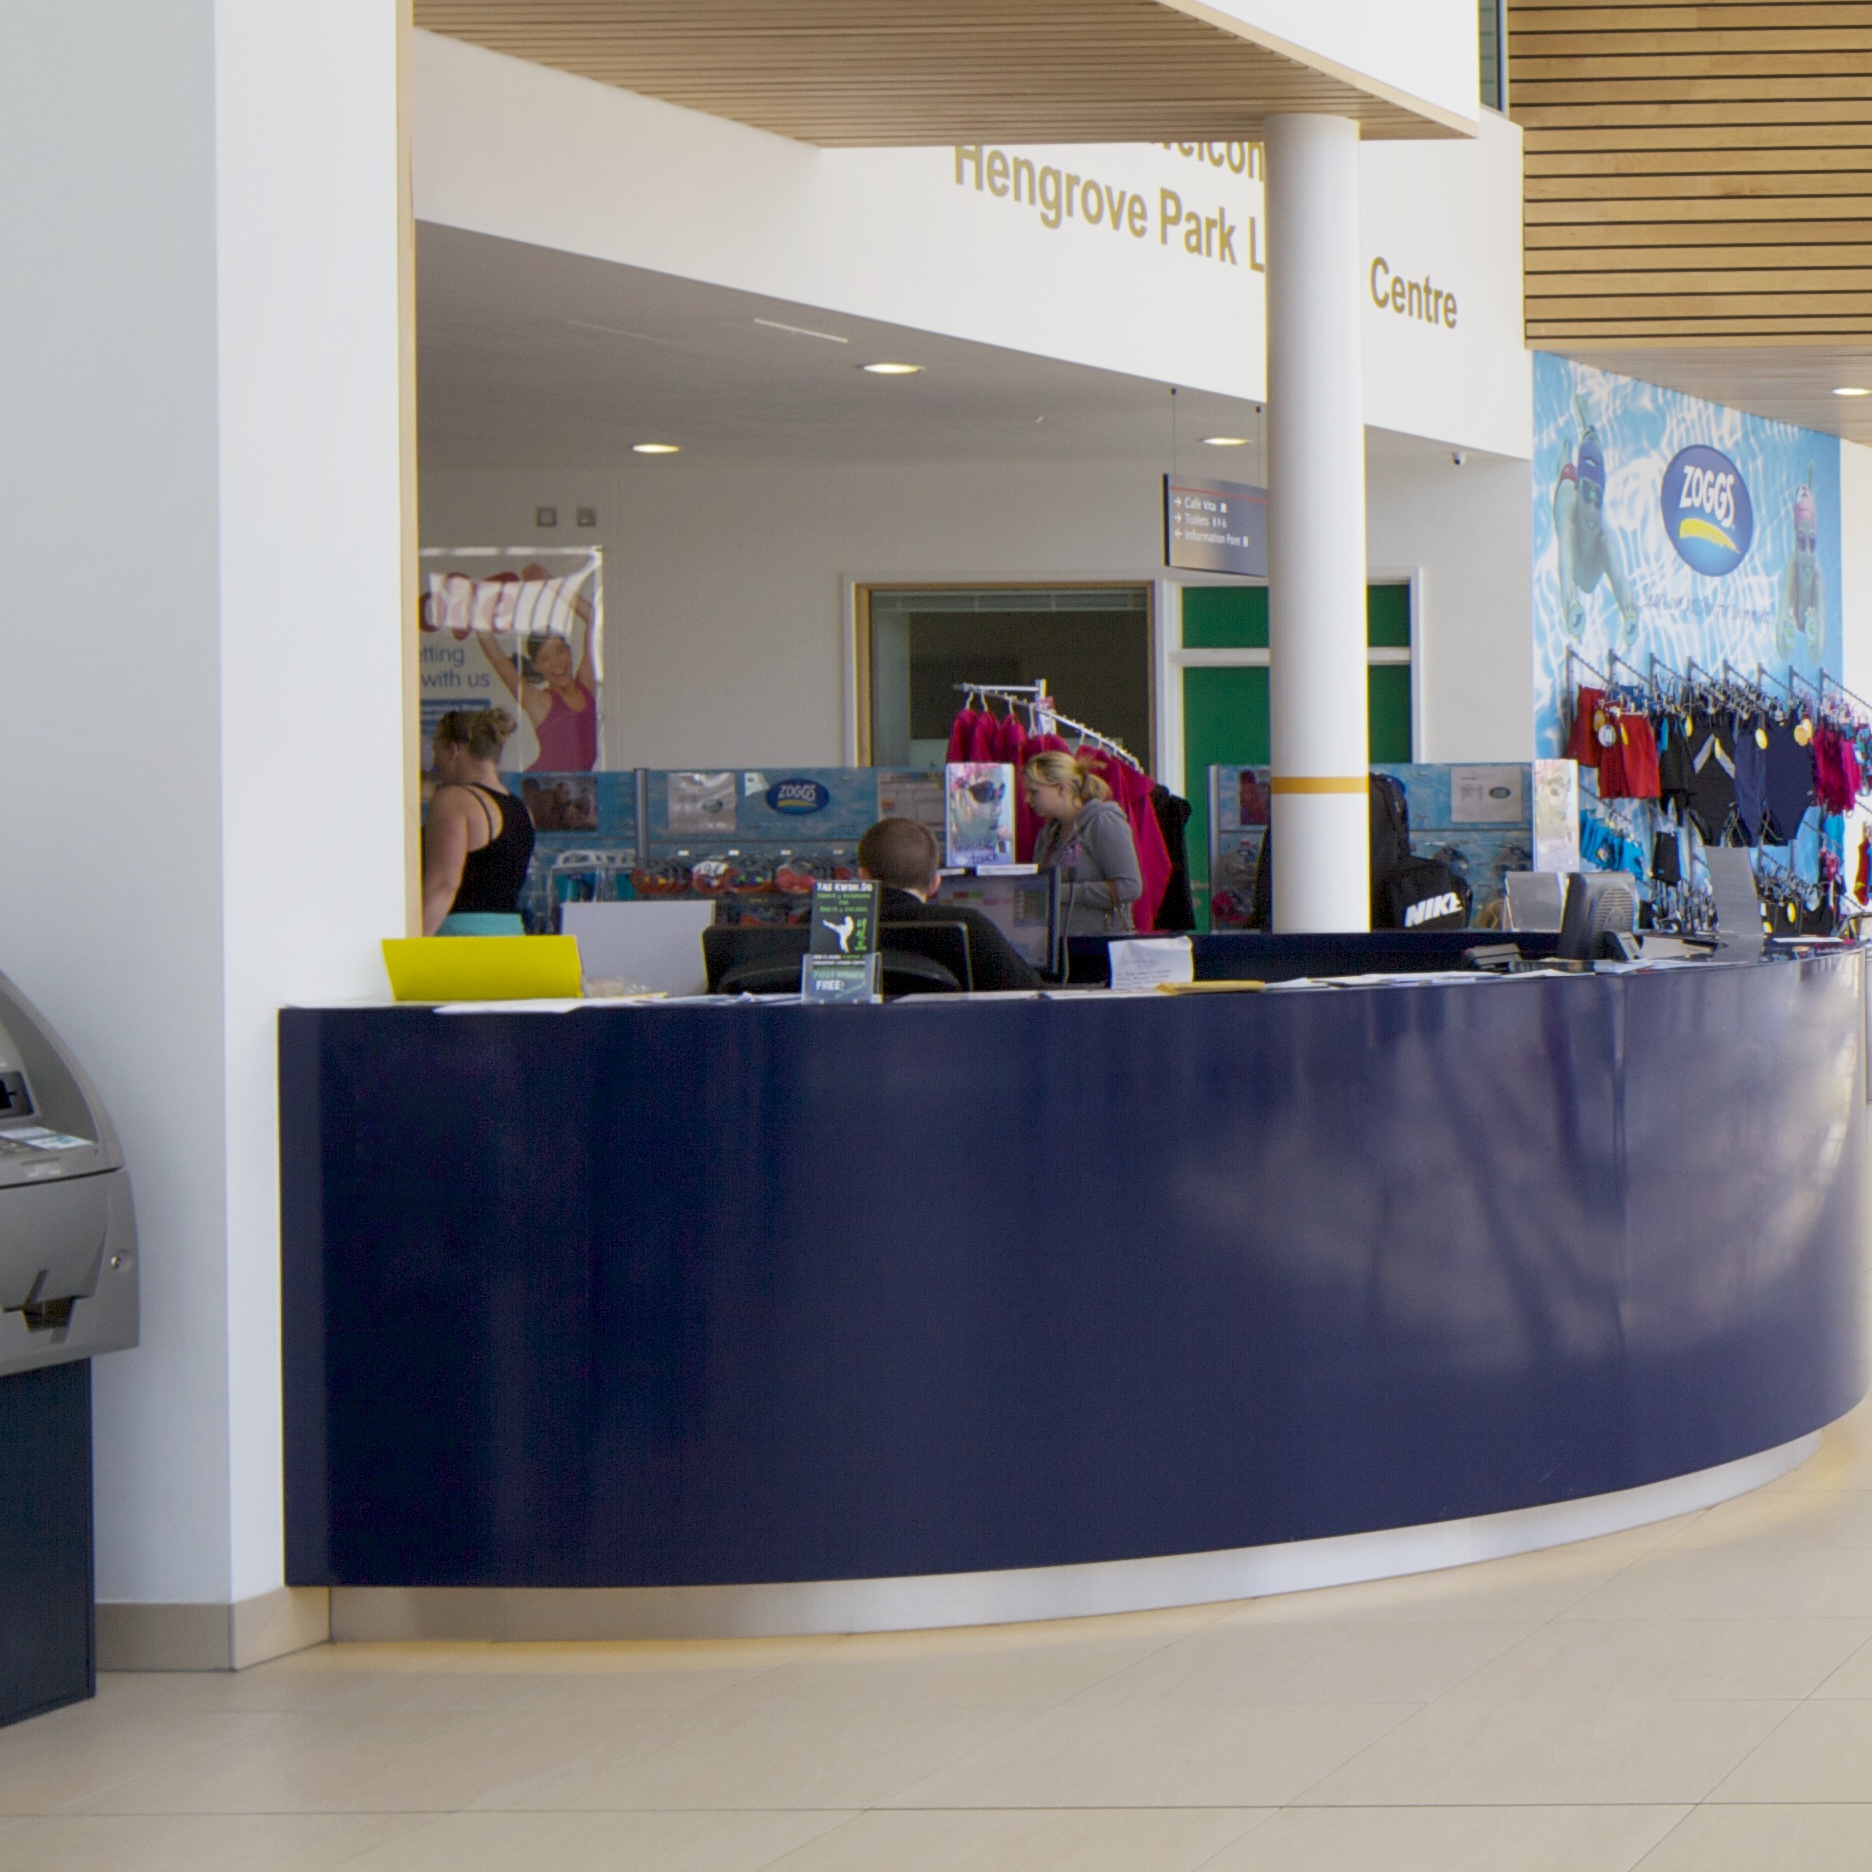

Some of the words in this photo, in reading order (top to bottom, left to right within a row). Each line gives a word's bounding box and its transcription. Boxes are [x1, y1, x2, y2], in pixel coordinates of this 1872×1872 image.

[954, 145, 1148, 239] Hengrove
[1160, 187, 1237, 266] Park
[1370, 256, 1457, 329] Centre
[1679, 465, 1735, 528] ZOGGS
[1184, 529, 1225, 544] Information
[420, 645, 464, 666] tting
[468, 673, 490, 688] us
[1404, 892, 1464, 928] NIKE
